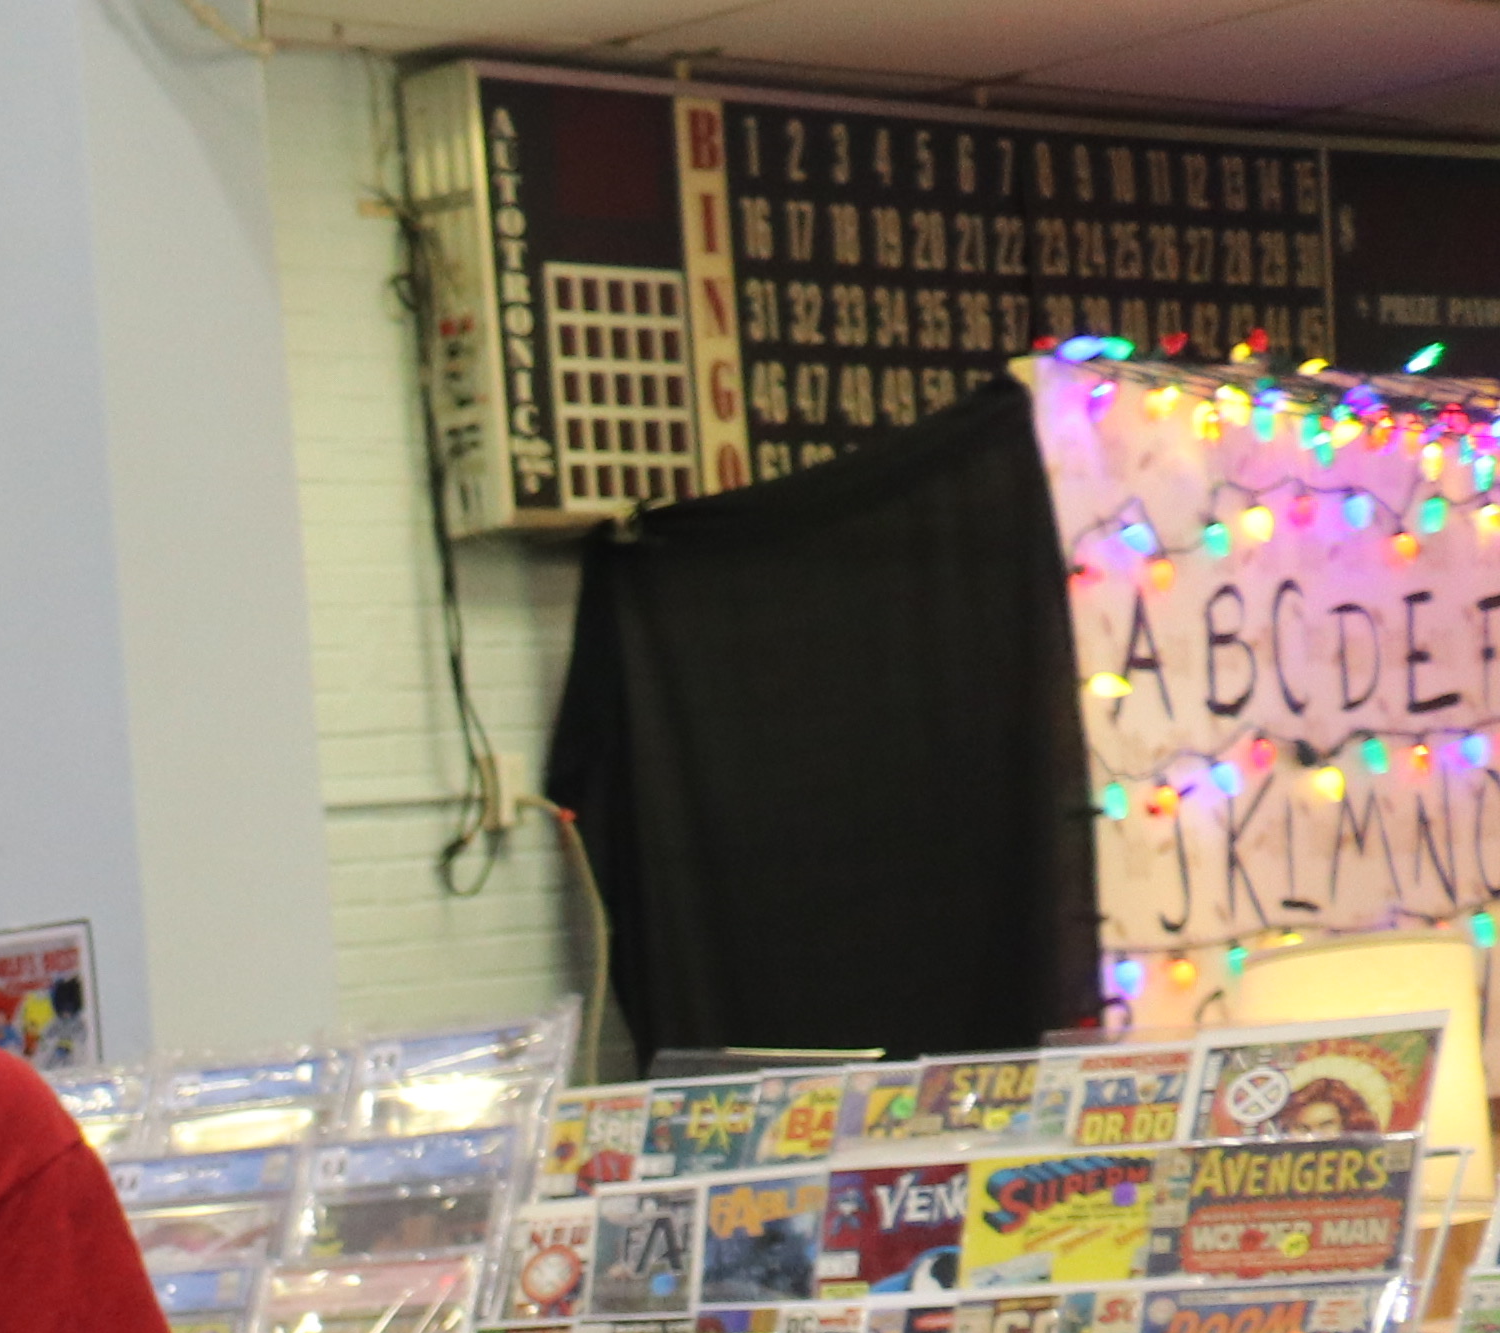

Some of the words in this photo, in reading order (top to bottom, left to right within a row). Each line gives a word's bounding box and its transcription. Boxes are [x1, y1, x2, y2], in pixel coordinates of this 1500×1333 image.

[786, 119, 806, 181] 2
[831, 123, 850, 184] 3
[915, 130, 934, 190] 5
[1190, 1148, 1388, 1198] AVENGERS
